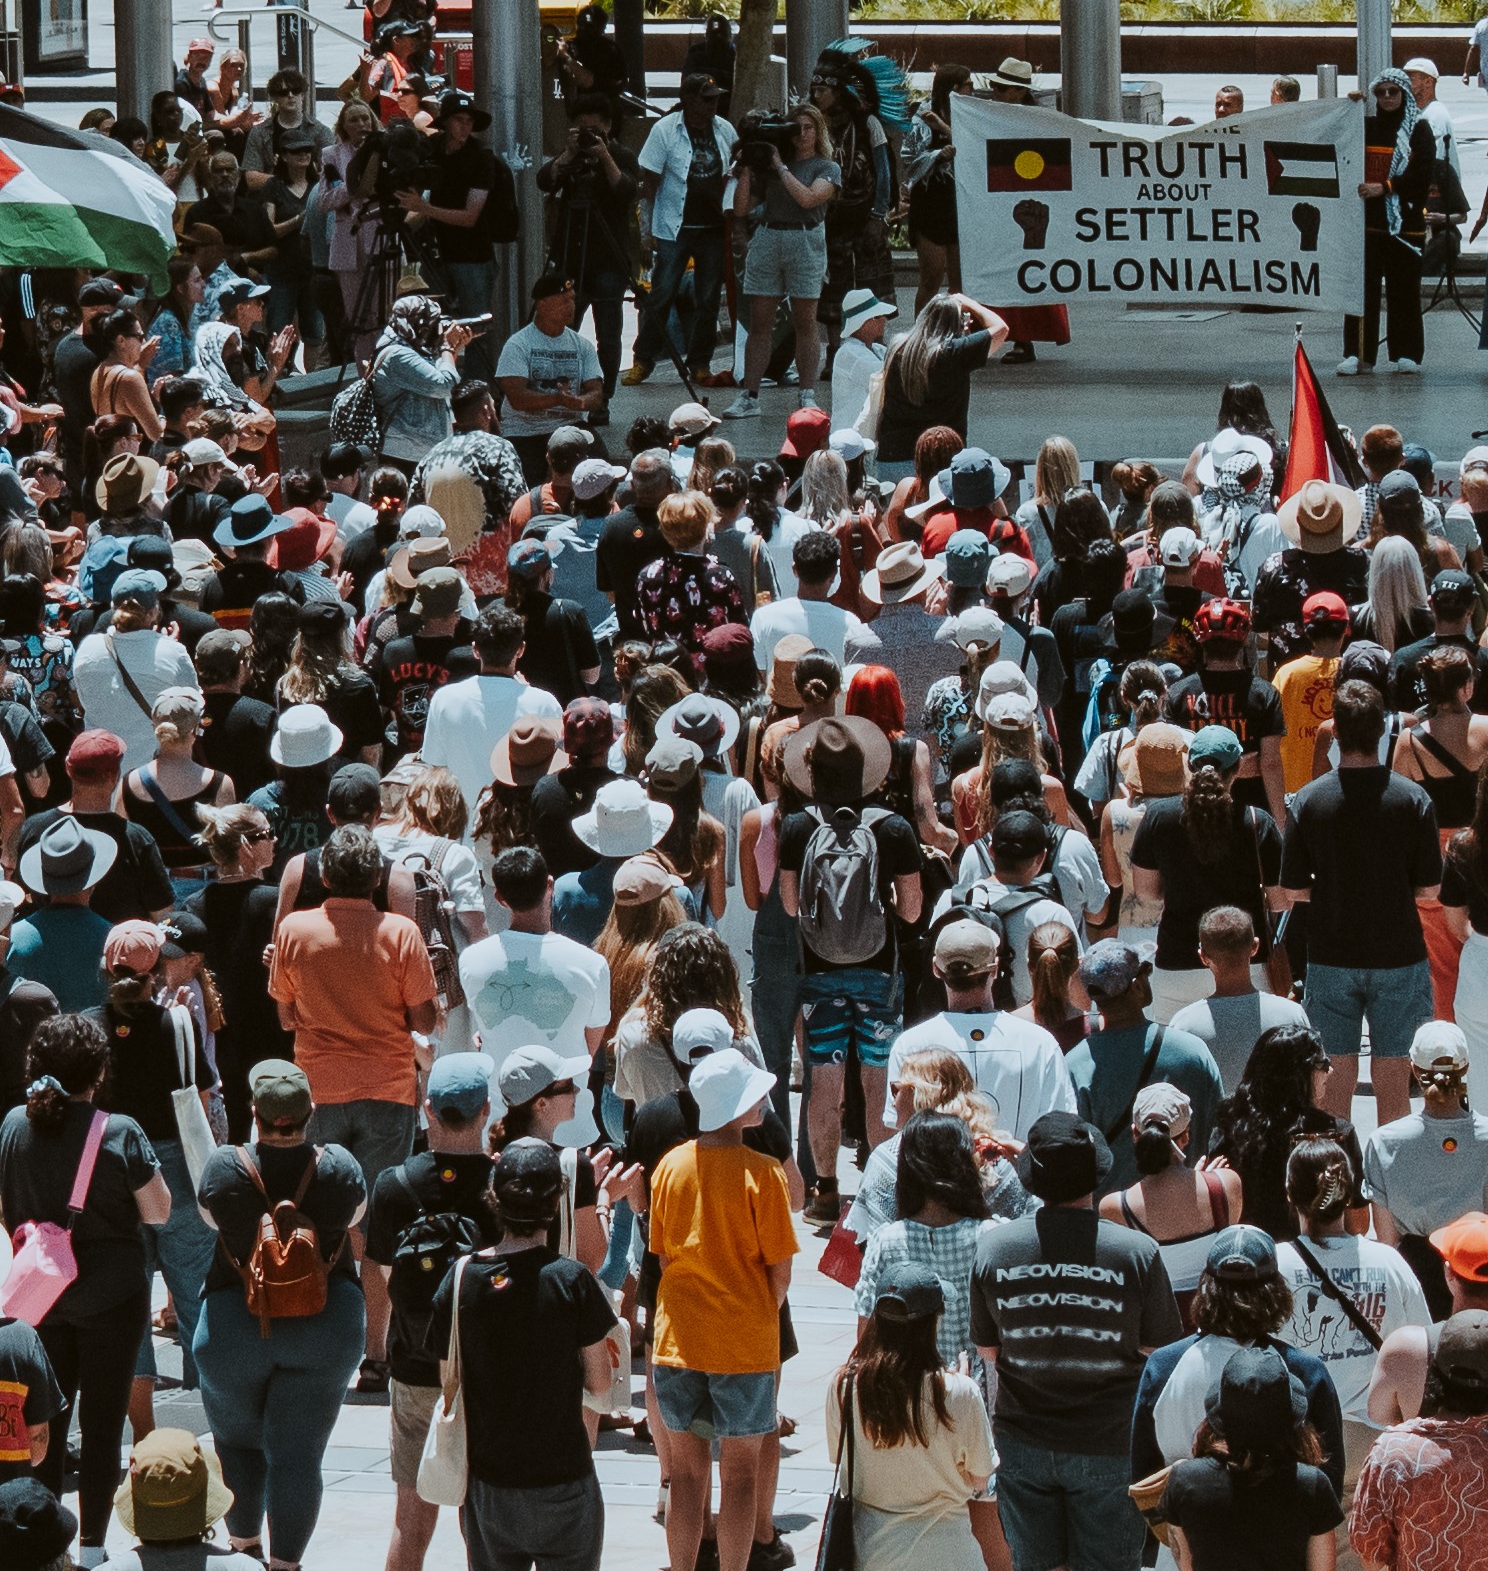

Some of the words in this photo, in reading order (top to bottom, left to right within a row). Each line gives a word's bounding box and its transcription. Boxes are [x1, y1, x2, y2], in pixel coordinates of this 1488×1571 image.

[1089, 141, 1249, 180] TRUTH
[1135, 182, 1213, 202] ABOUT
[1074, 206, 1262, 244] SETTLER
[1016, 256, 1322, 297] COLONIALISM
[390, 662, 451, 684] LUCY'S
[996, 1263, 1124, 1286] NEOVISION
[1332, 1267, 1360, 1283] CAN'T
[996, 1292, 1123, 1314] NEOVISION
